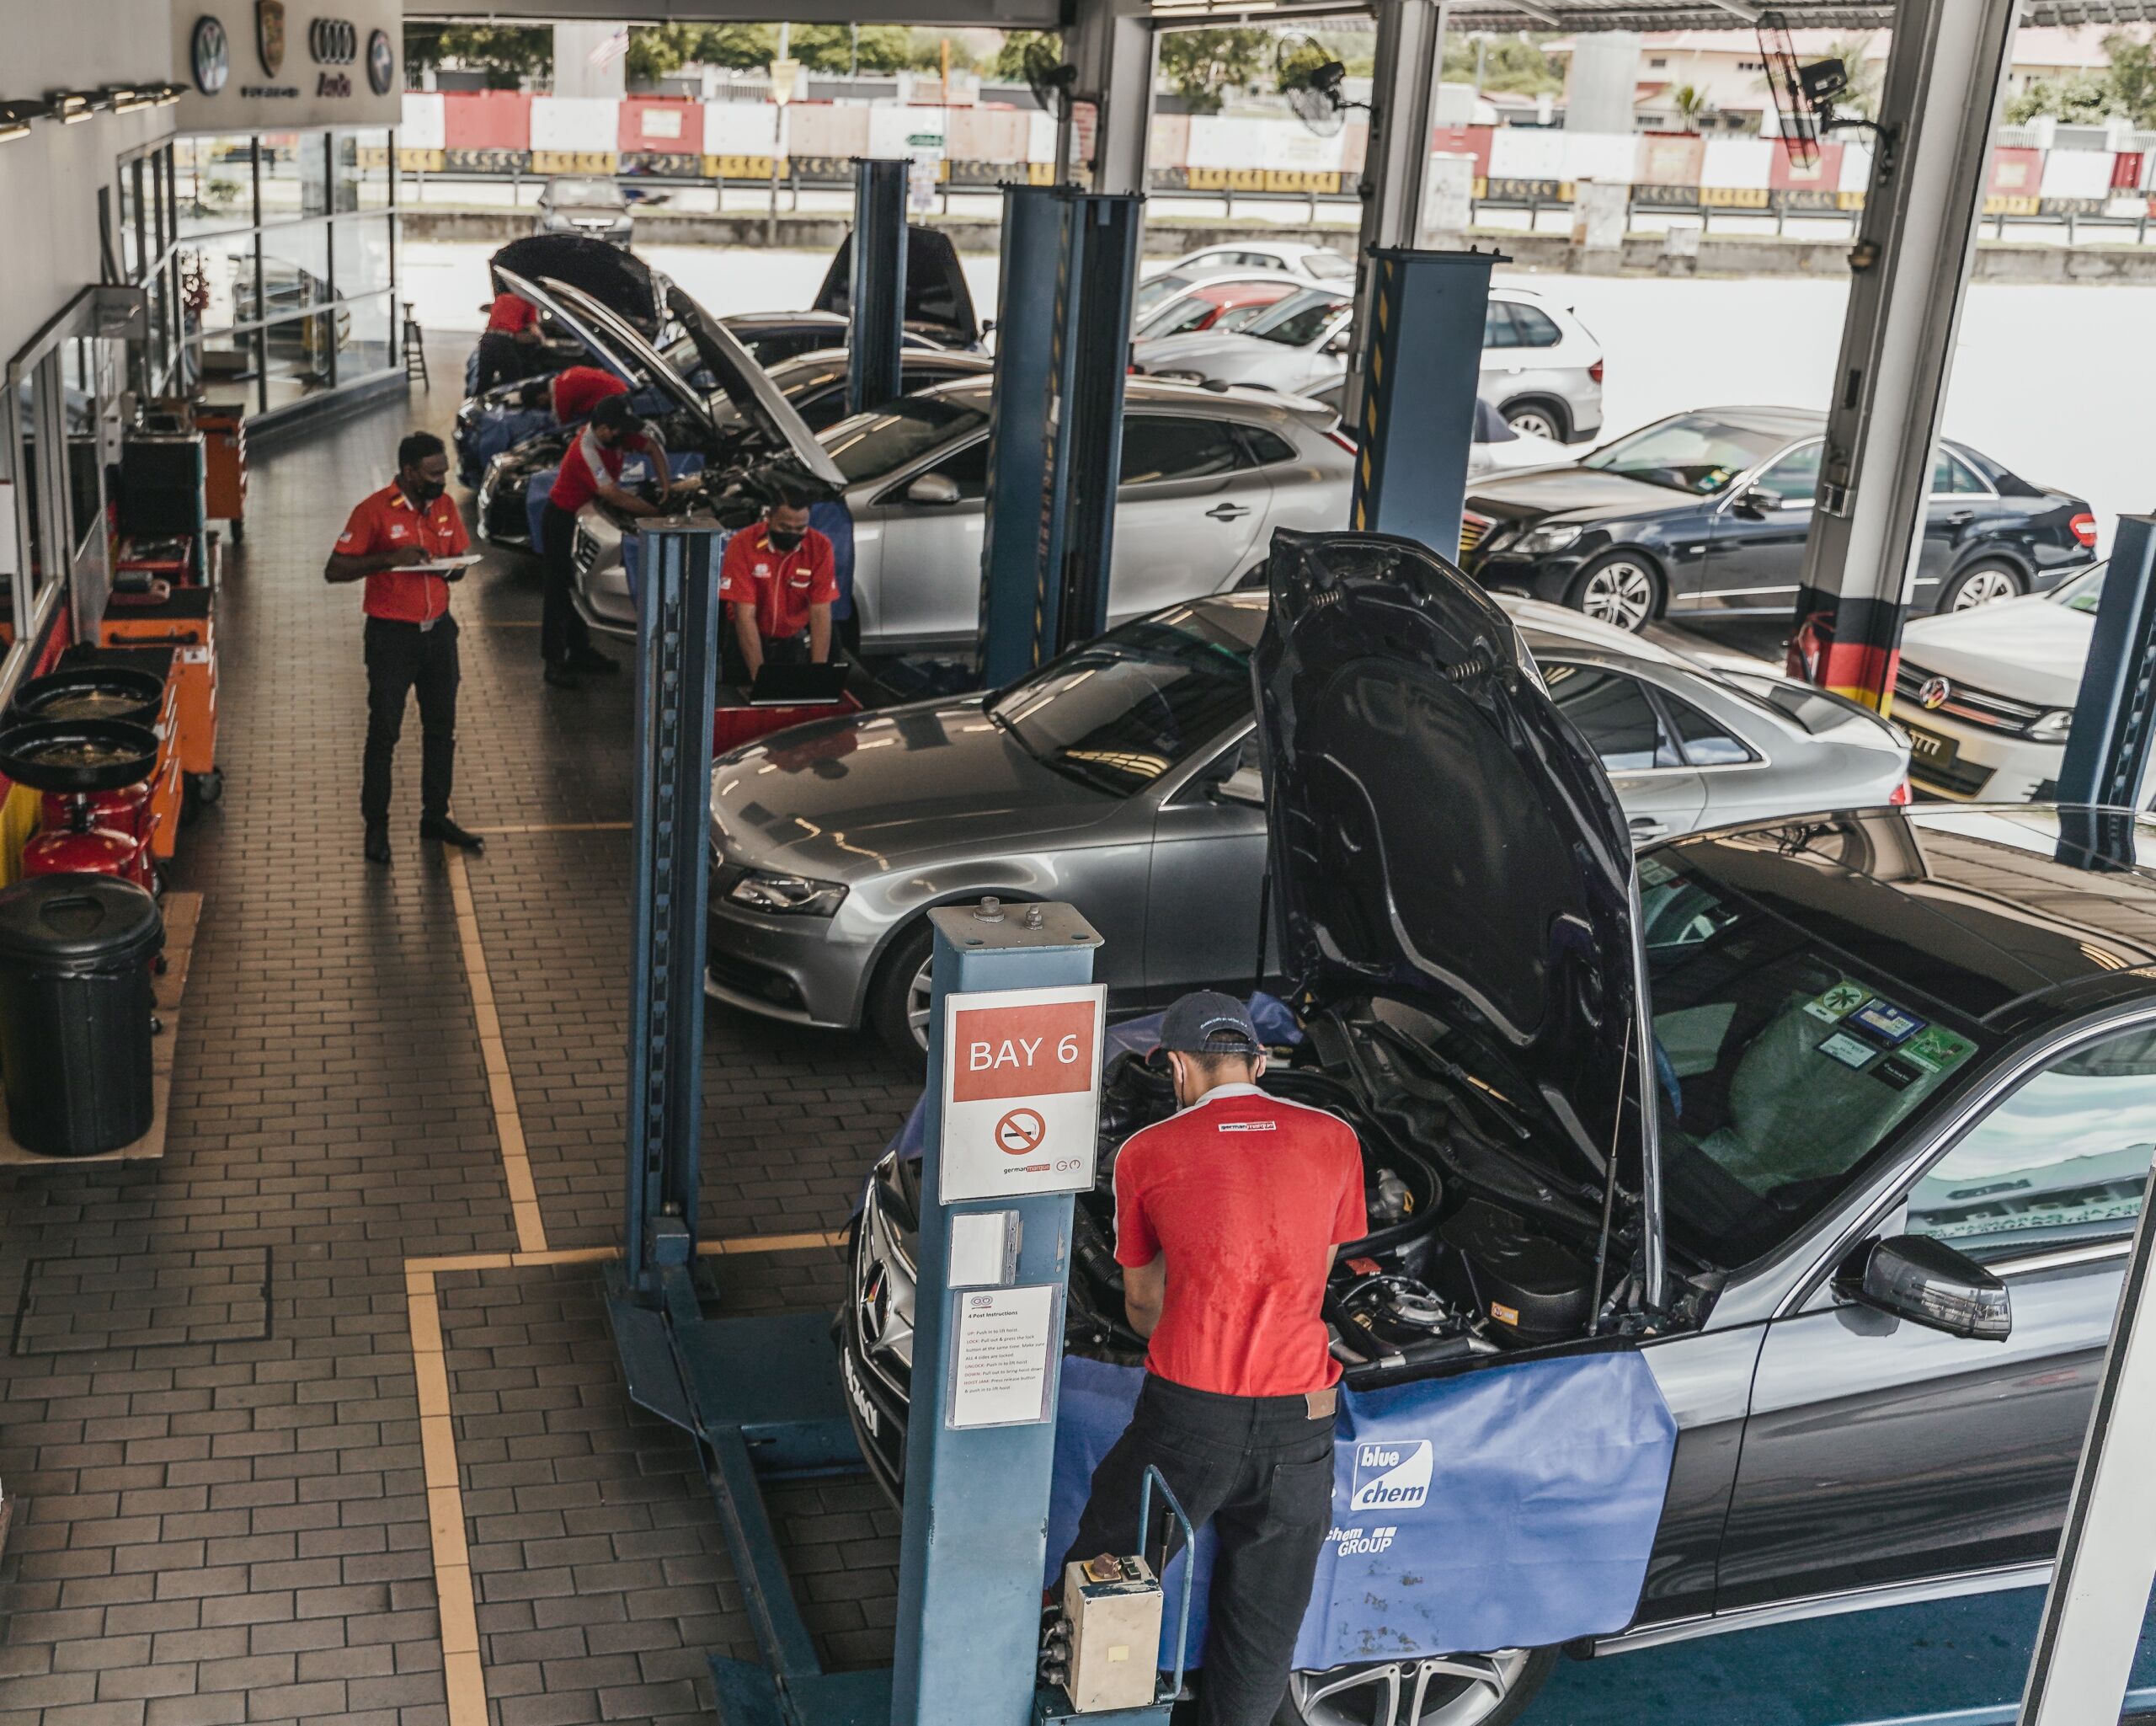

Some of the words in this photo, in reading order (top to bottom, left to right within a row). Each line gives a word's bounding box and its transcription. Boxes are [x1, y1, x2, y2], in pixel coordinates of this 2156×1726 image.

[969, 1037, 1043, 1071] BAY
[1057, 1034, 1079, 1064] 6
[1361, 1446, 1400, 1467] blue
[1362, 1481, 1424, 1504] chem
[1337, 1537, 1392, 1557] GROUP
